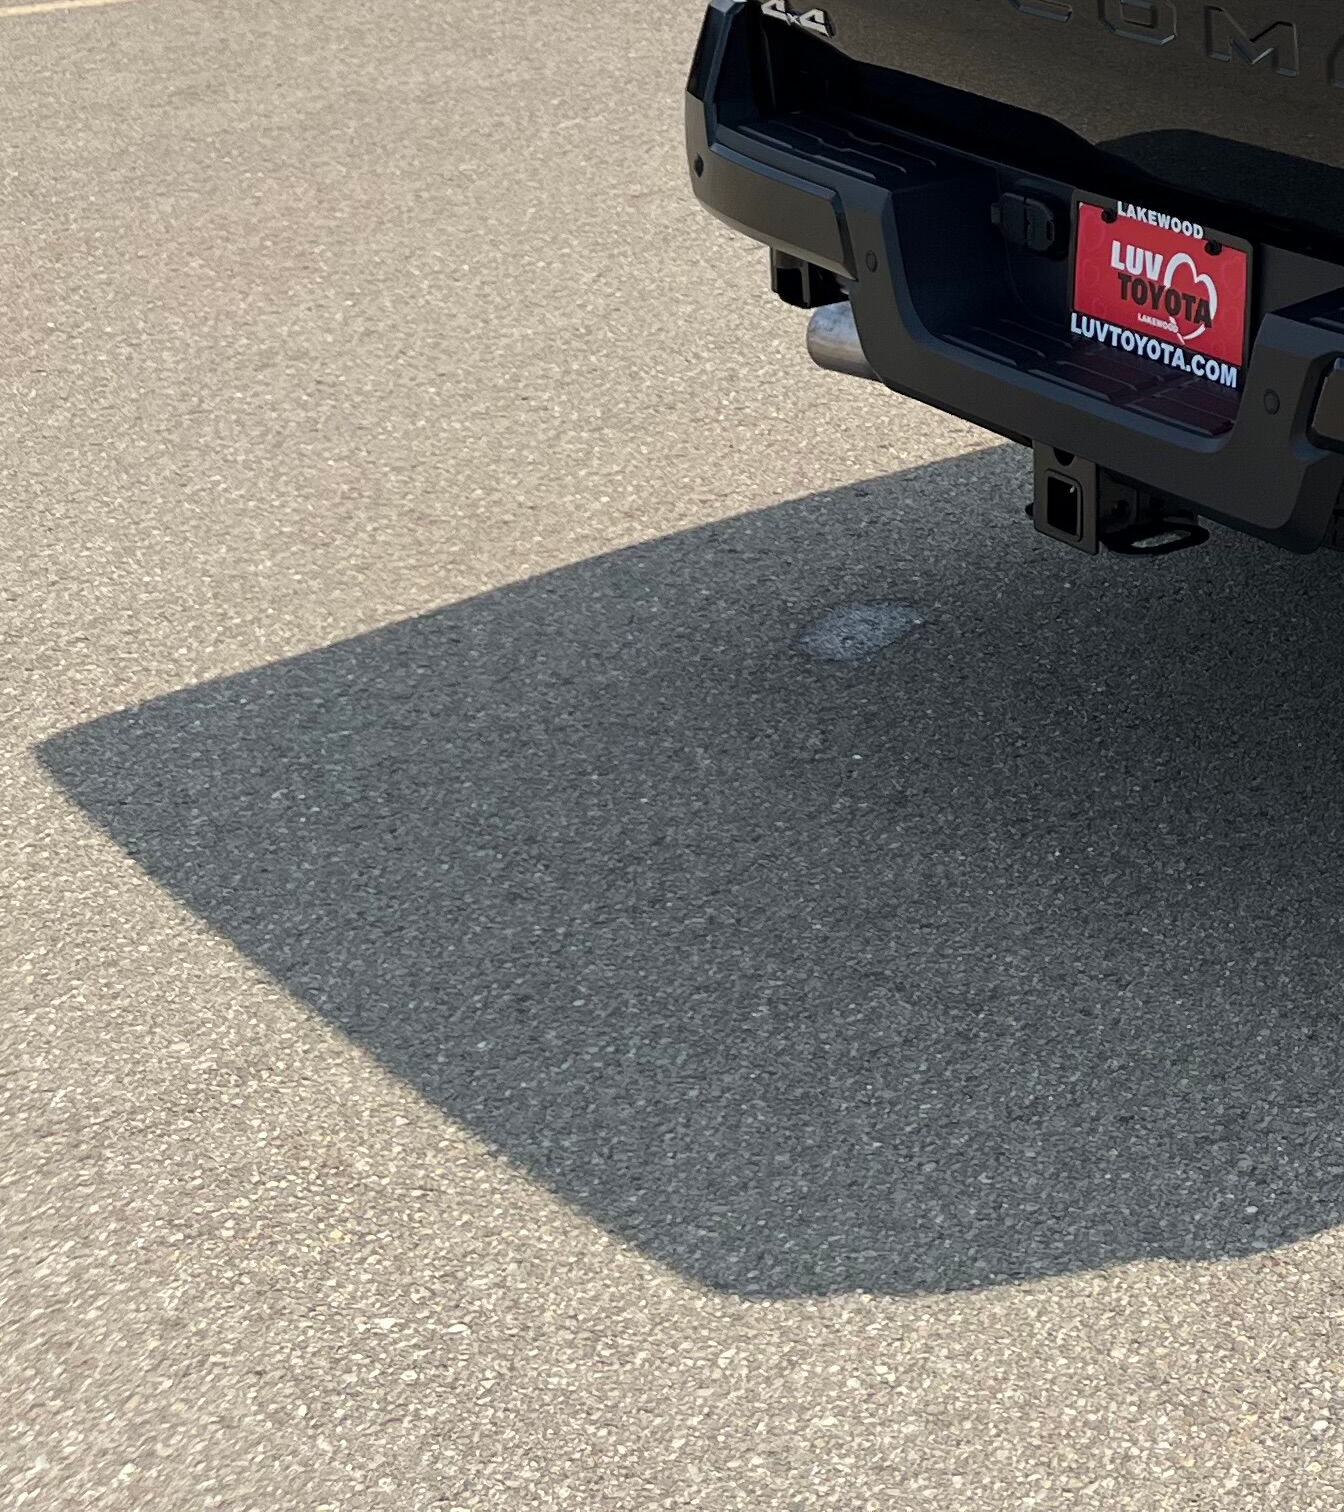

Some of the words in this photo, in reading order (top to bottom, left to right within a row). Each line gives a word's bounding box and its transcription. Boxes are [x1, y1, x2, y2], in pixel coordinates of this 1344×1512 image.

[1117, 201, 1204, 239] LAKEWOOD
[1110, 240, 1163, 281] LUV
[1118, 272, 1212, 329] TOYOTA
[1137, 312, 1179, 333] LAKEWOOD
[1070, 312, 1237, 388] LUVTOYOTA.COM
